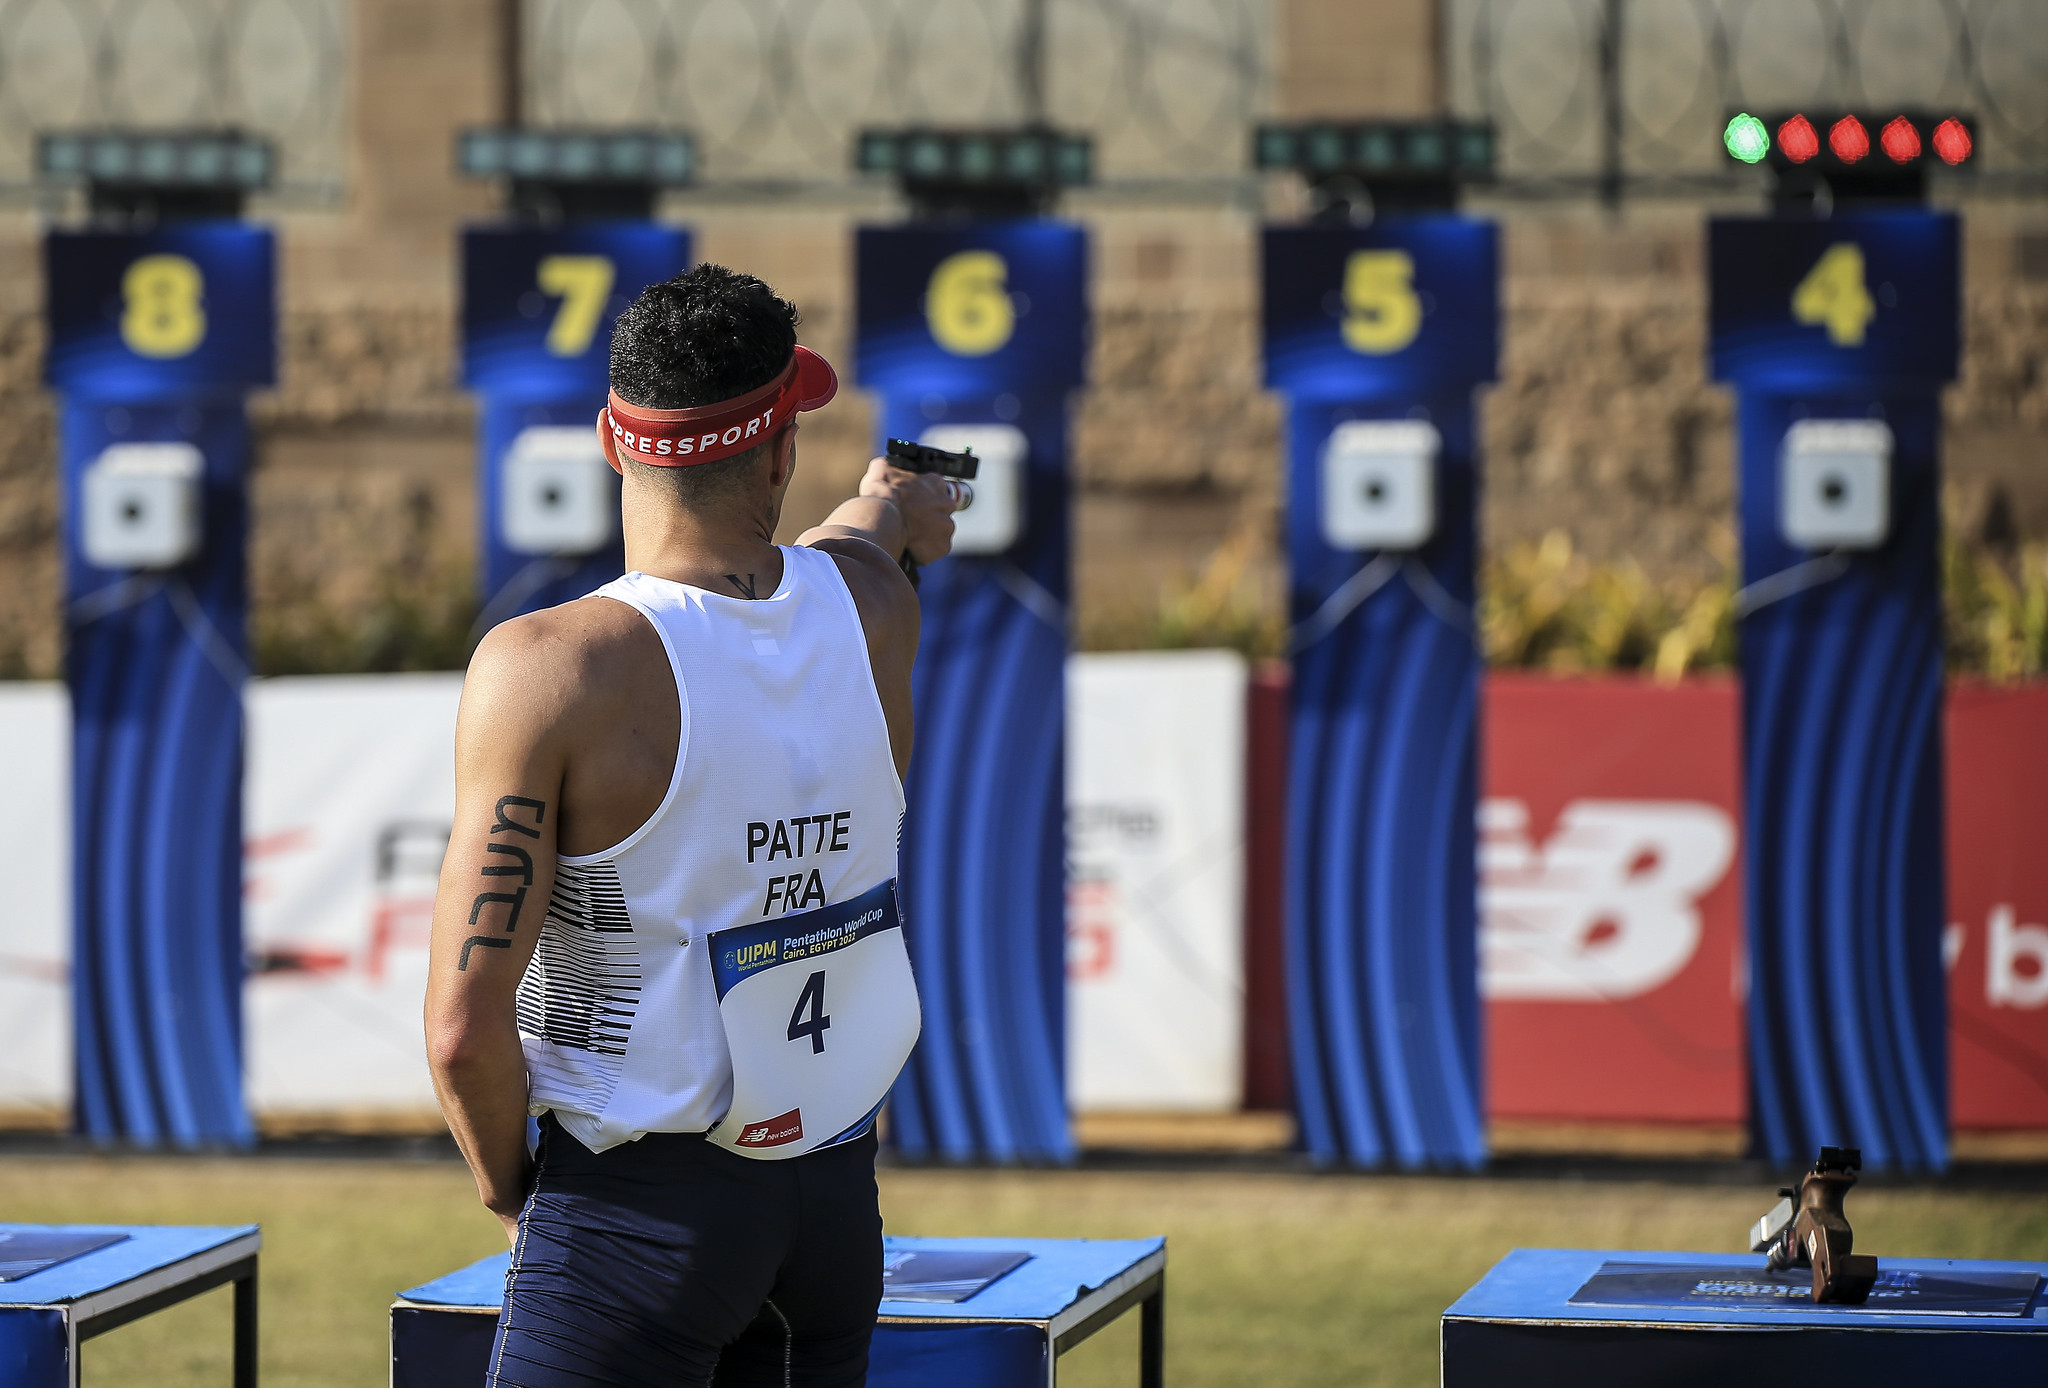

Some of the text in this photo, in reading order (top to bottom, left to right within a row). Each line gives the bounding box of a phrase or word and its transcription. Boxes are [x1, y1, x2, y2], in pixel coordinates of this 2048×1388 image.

[120, 253, 207, 359] 8
[537, 254, 615, 358] 7
[925, 250, 1016, 356] 6
[1341, 249, 1424, 356] 5
[1790, 242, 1877, 348] 4
[746, 810, 852, 864] PATTE
[762, 867, 827, 917] FRA
[783, 907, 883, 950] Pentathlon World Cup
[737, 940, 777, 965] UIPM
[783, 932, 856, 961] Cairo, EGYPT 2022
[786, 969, 832, 1056] 4
